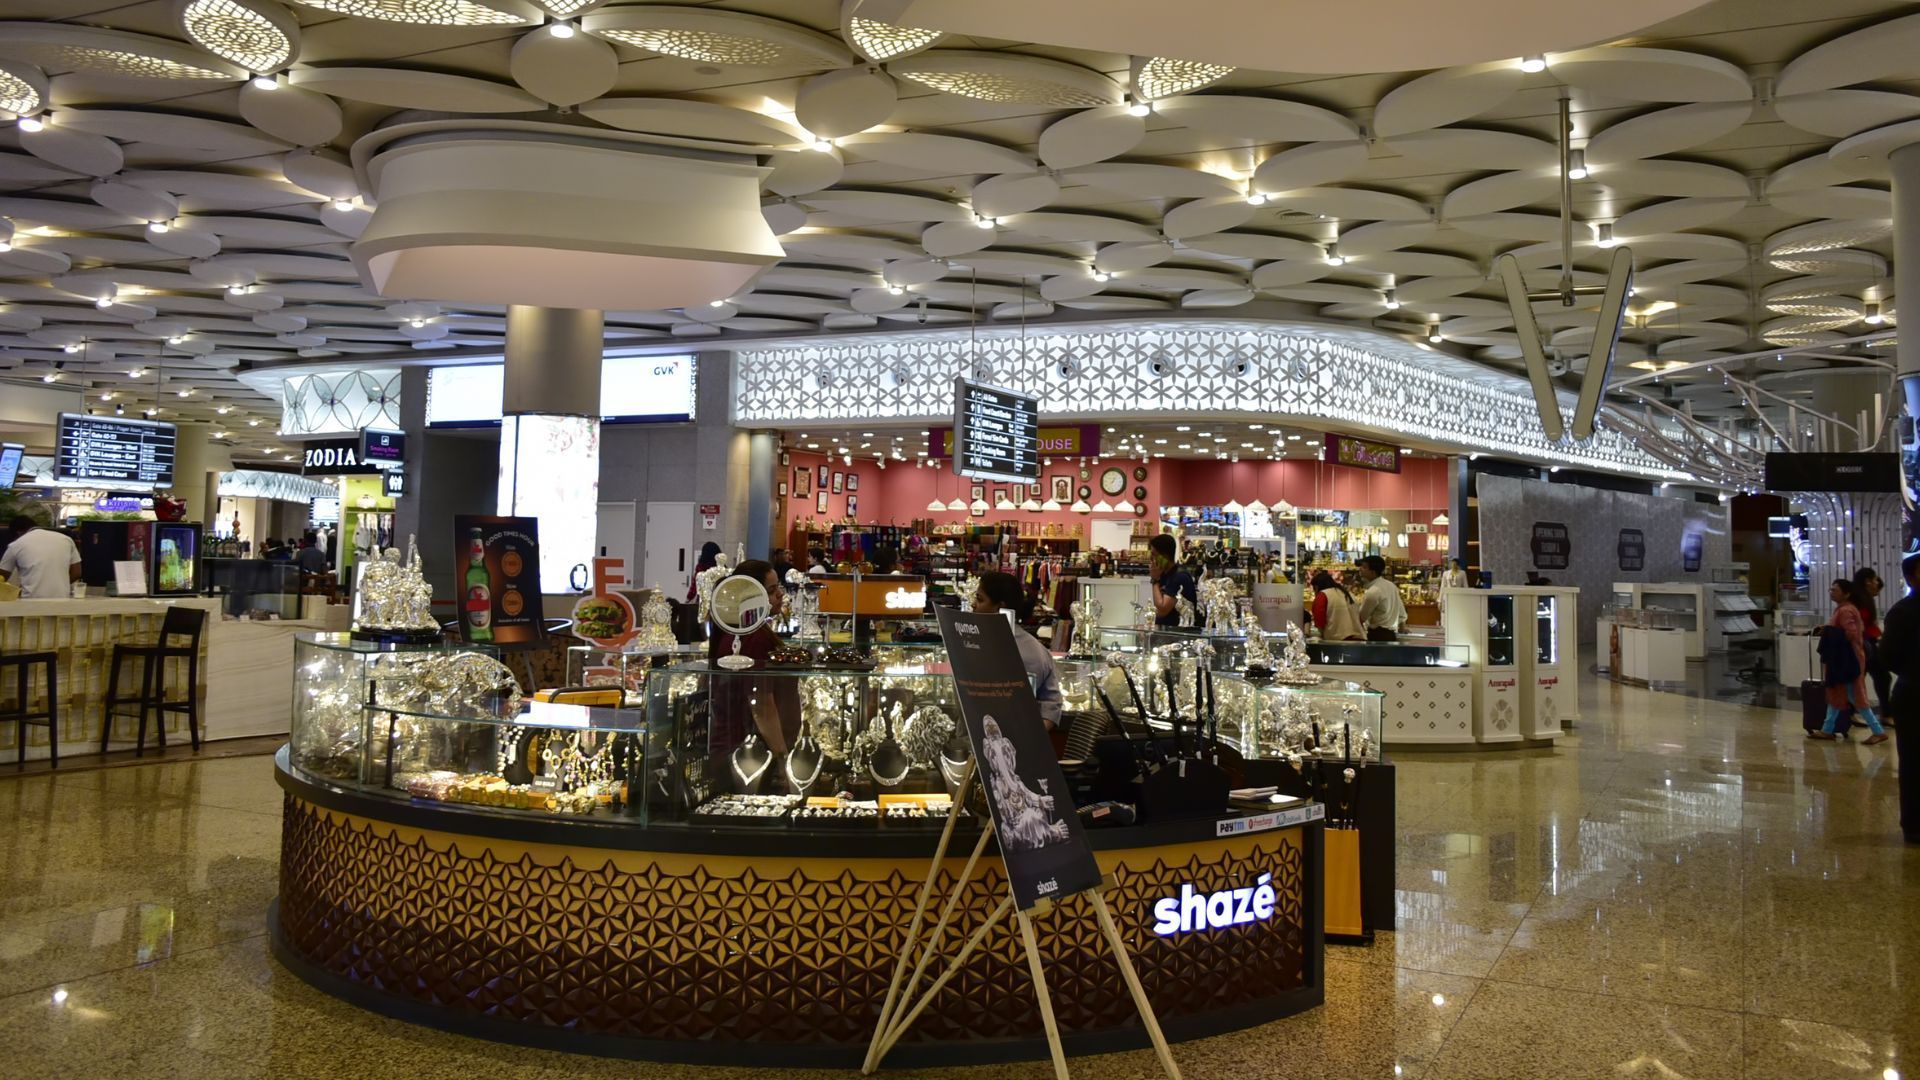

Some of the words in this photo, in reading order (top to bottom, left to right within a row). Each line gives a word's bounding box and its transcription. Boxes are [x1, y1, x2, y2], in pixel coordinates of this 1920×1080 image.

[654, 366, 674, 376] GVK
[101, 442, 122, 450] Lounges
[1038, 439, 1073, 450] OUSE
[101, 451, 121, 459] Lounges
[305, 447, 367, 467] ZODIA
[485, 531, 503, 547] GOOD
[519, 532, 535, 547] HOUR
[1258, 594, 1292, 605] Amrapali
[1488, 678, 1516, 688] Amrapali
[1538, 676, 1558, 686] Amrapali
[1037, 877, 1058, 895] shazé
[1153, 871, 1276, 936] shazé
